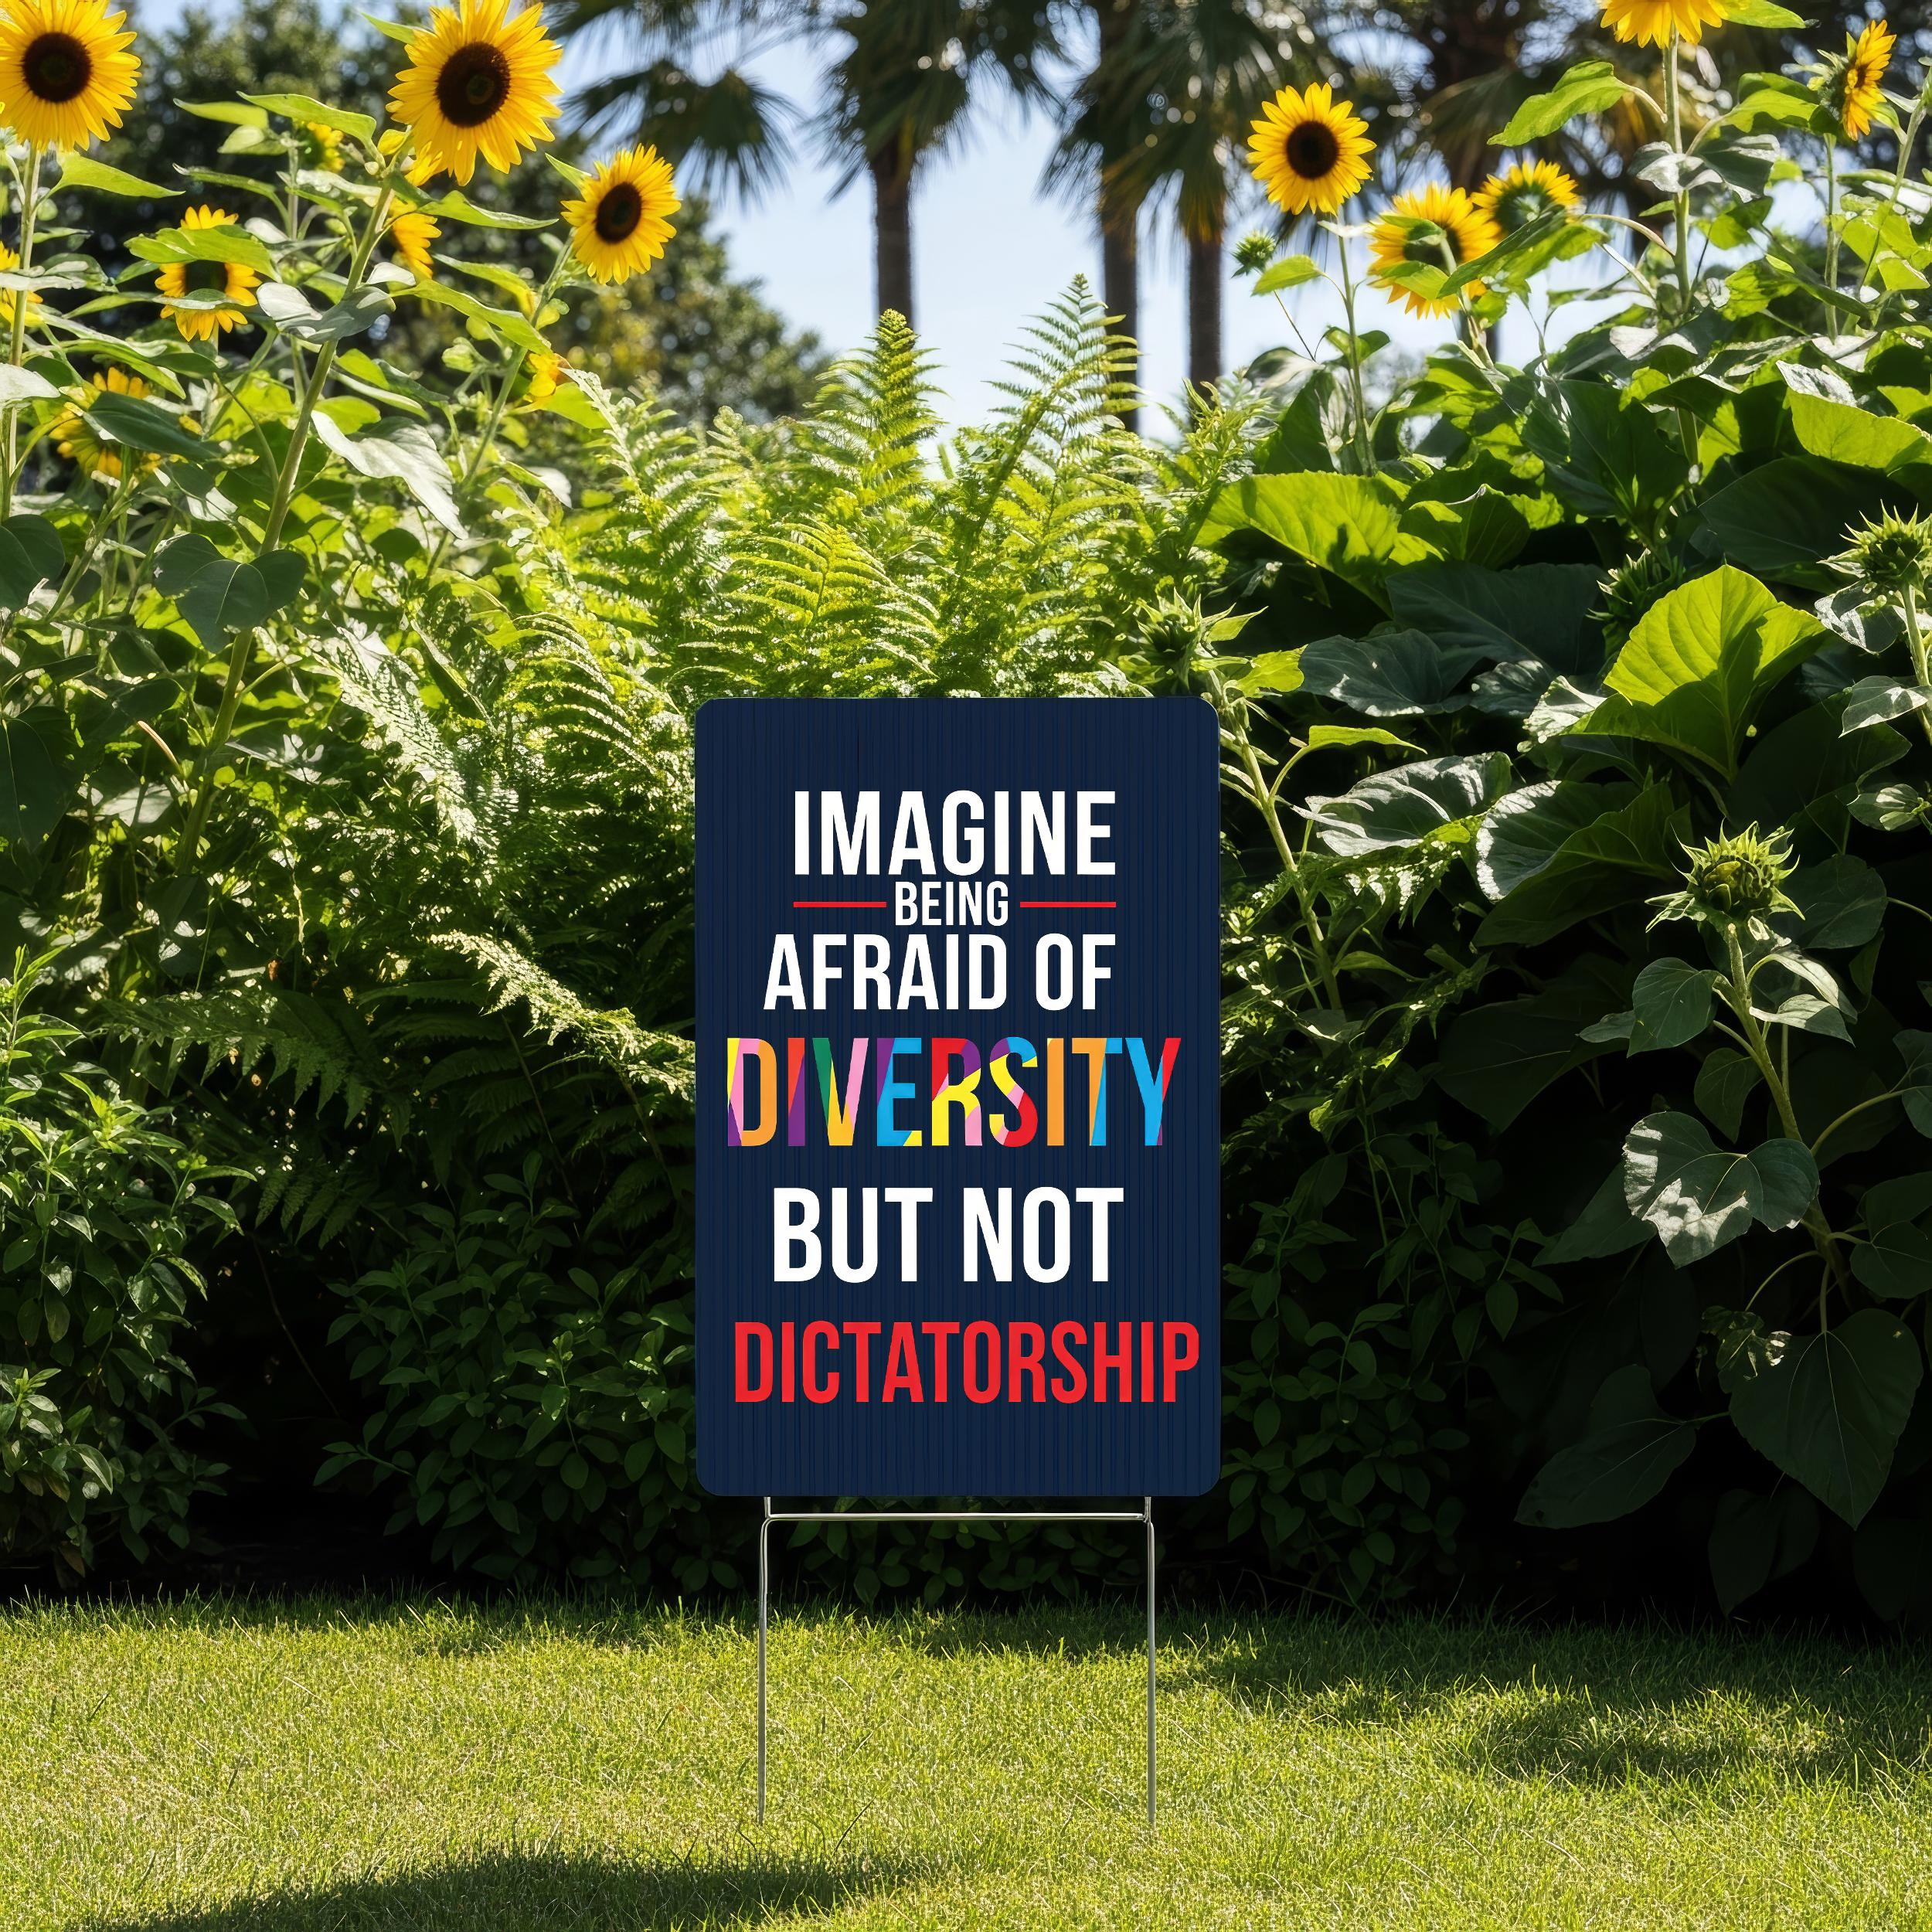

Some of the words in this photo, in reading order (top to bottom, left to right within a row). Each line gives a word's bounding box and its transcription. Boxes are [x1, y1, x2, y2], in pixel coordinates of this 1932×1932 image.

[794, 790, 1116, 876] IMAGINE
[895, 880, 1009, 927] BEING
[763, 934, 1007, 1010] AFRAID
[1036, 933, 1116, 1011] OF
[726, 1036, 1182, 1148] DIVERSITY
[774, 1187, 934, 1284] BUT
[963, 1186, 1124, 1284] NOT
[734, 1320, 1199, 1404] DICTATORSHIP
